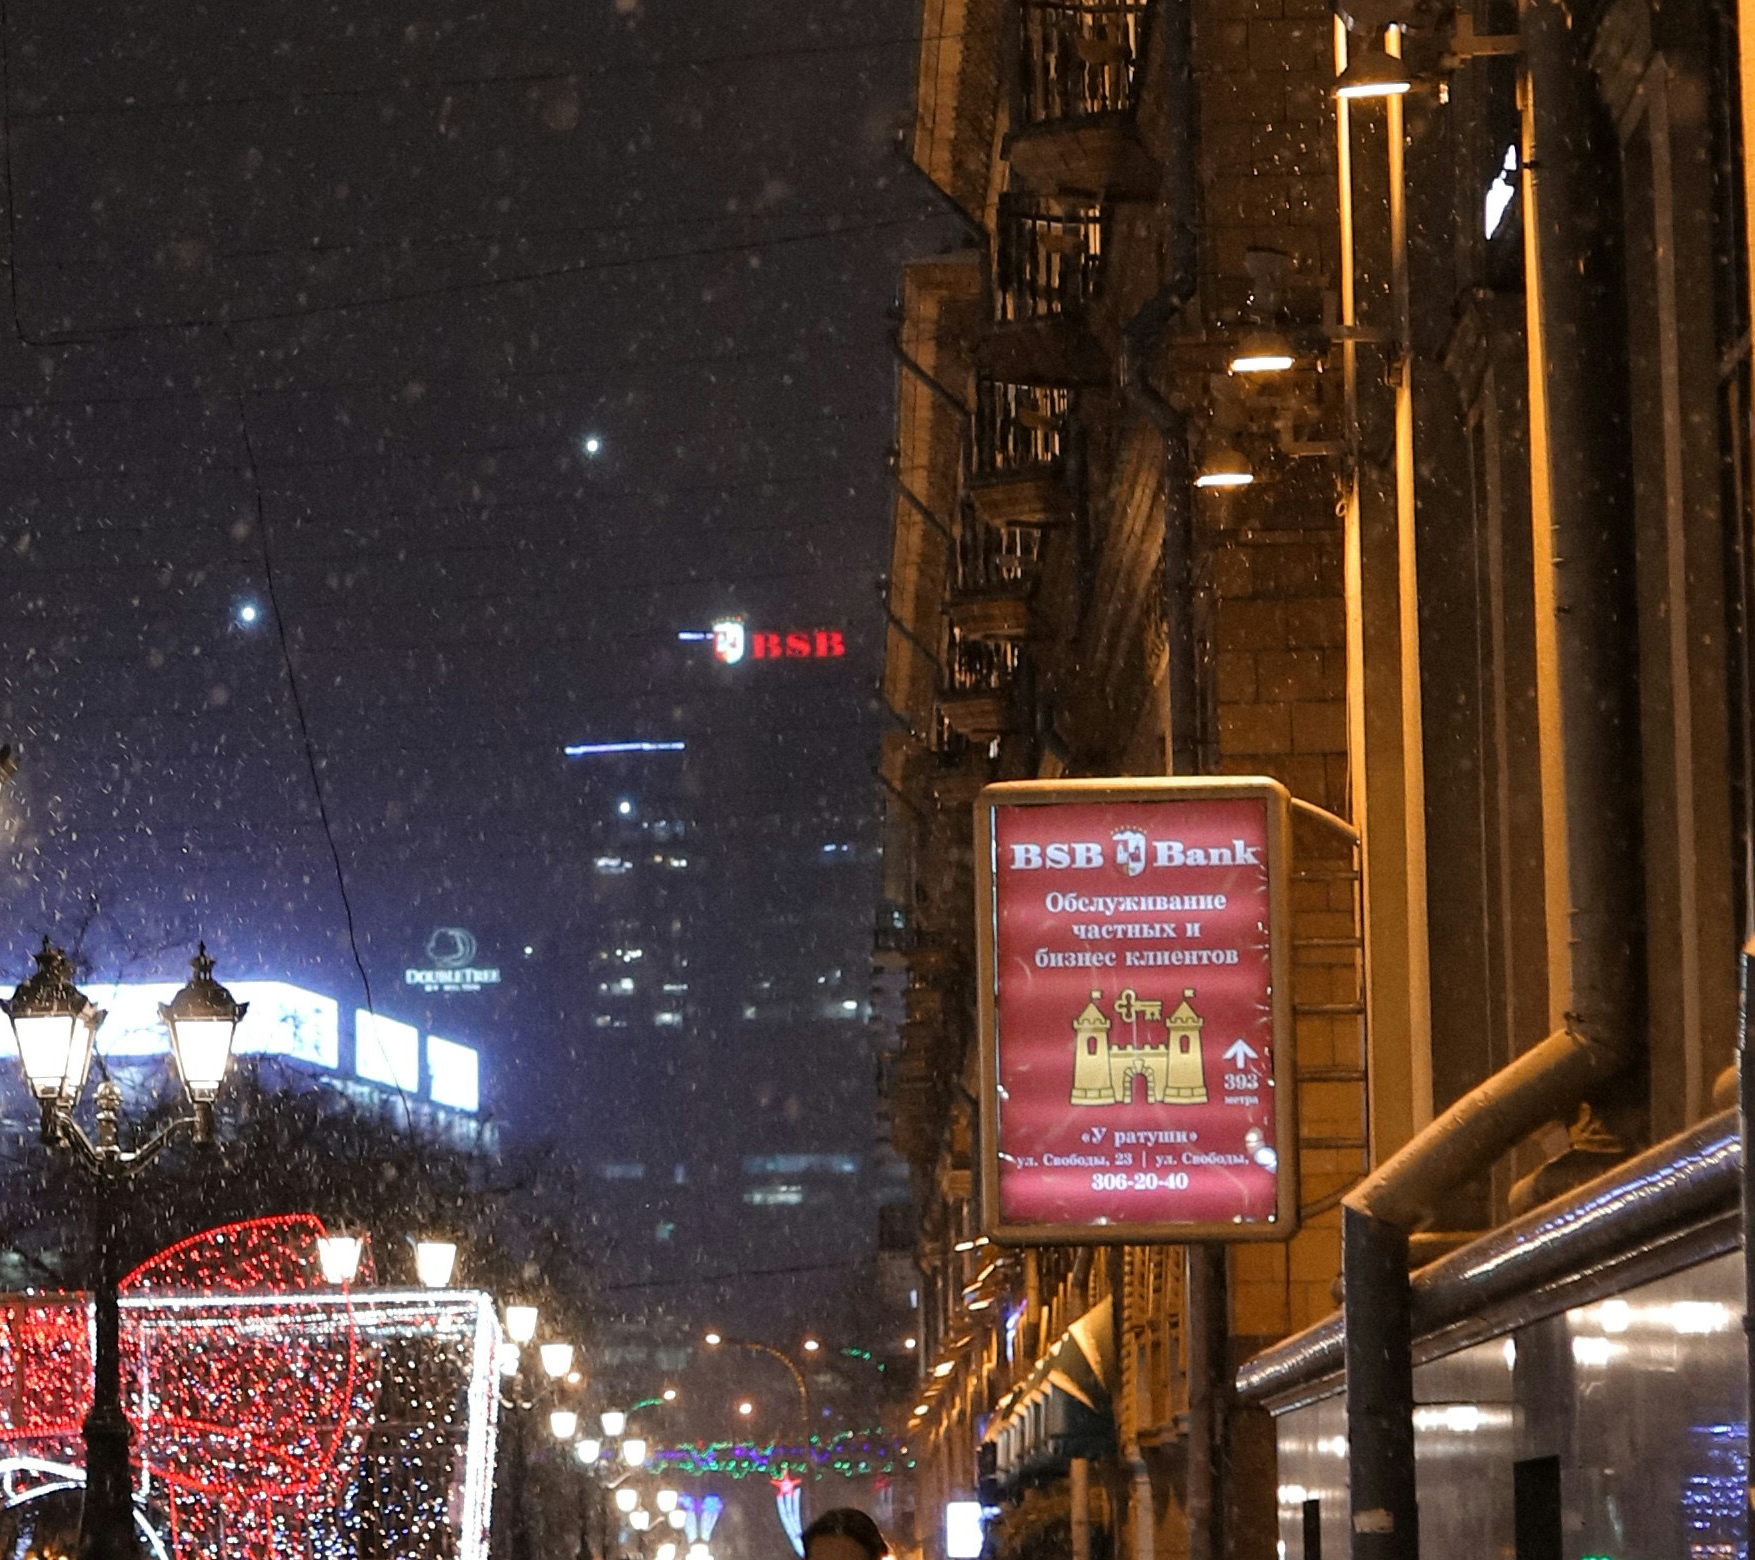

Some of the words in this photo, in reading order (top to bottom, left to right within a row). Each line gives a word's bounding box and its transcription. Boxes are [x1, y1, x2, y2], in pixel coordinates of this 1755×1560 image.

[753, 631, 845, 660] BSB
[1010, 842, 1104, 870] BSB
[1153, 839, 1261, 868] Bank
[1045, 891, 1227, 916] Обслуживание
[1072, 922, 1177, 939] частных
[1185, 922, 1201, 938] и
[1035, 948, 1117, 968] бизнес
[1125, 949, 1239, 967] клиентов
[1223, 1073, 1259, 1091] 393
[1223, 1095, 1259, 1107] метра
[1016, 1156, 1039, 1169] ул.
[1043, 1152, 1110, 1168] Свободы,
[1114, 1152, 1133, 1166] 23
[1155, 1154, 1177, 1167] ул.
[1091, 1172, 1189, 1191] 306-20-40
